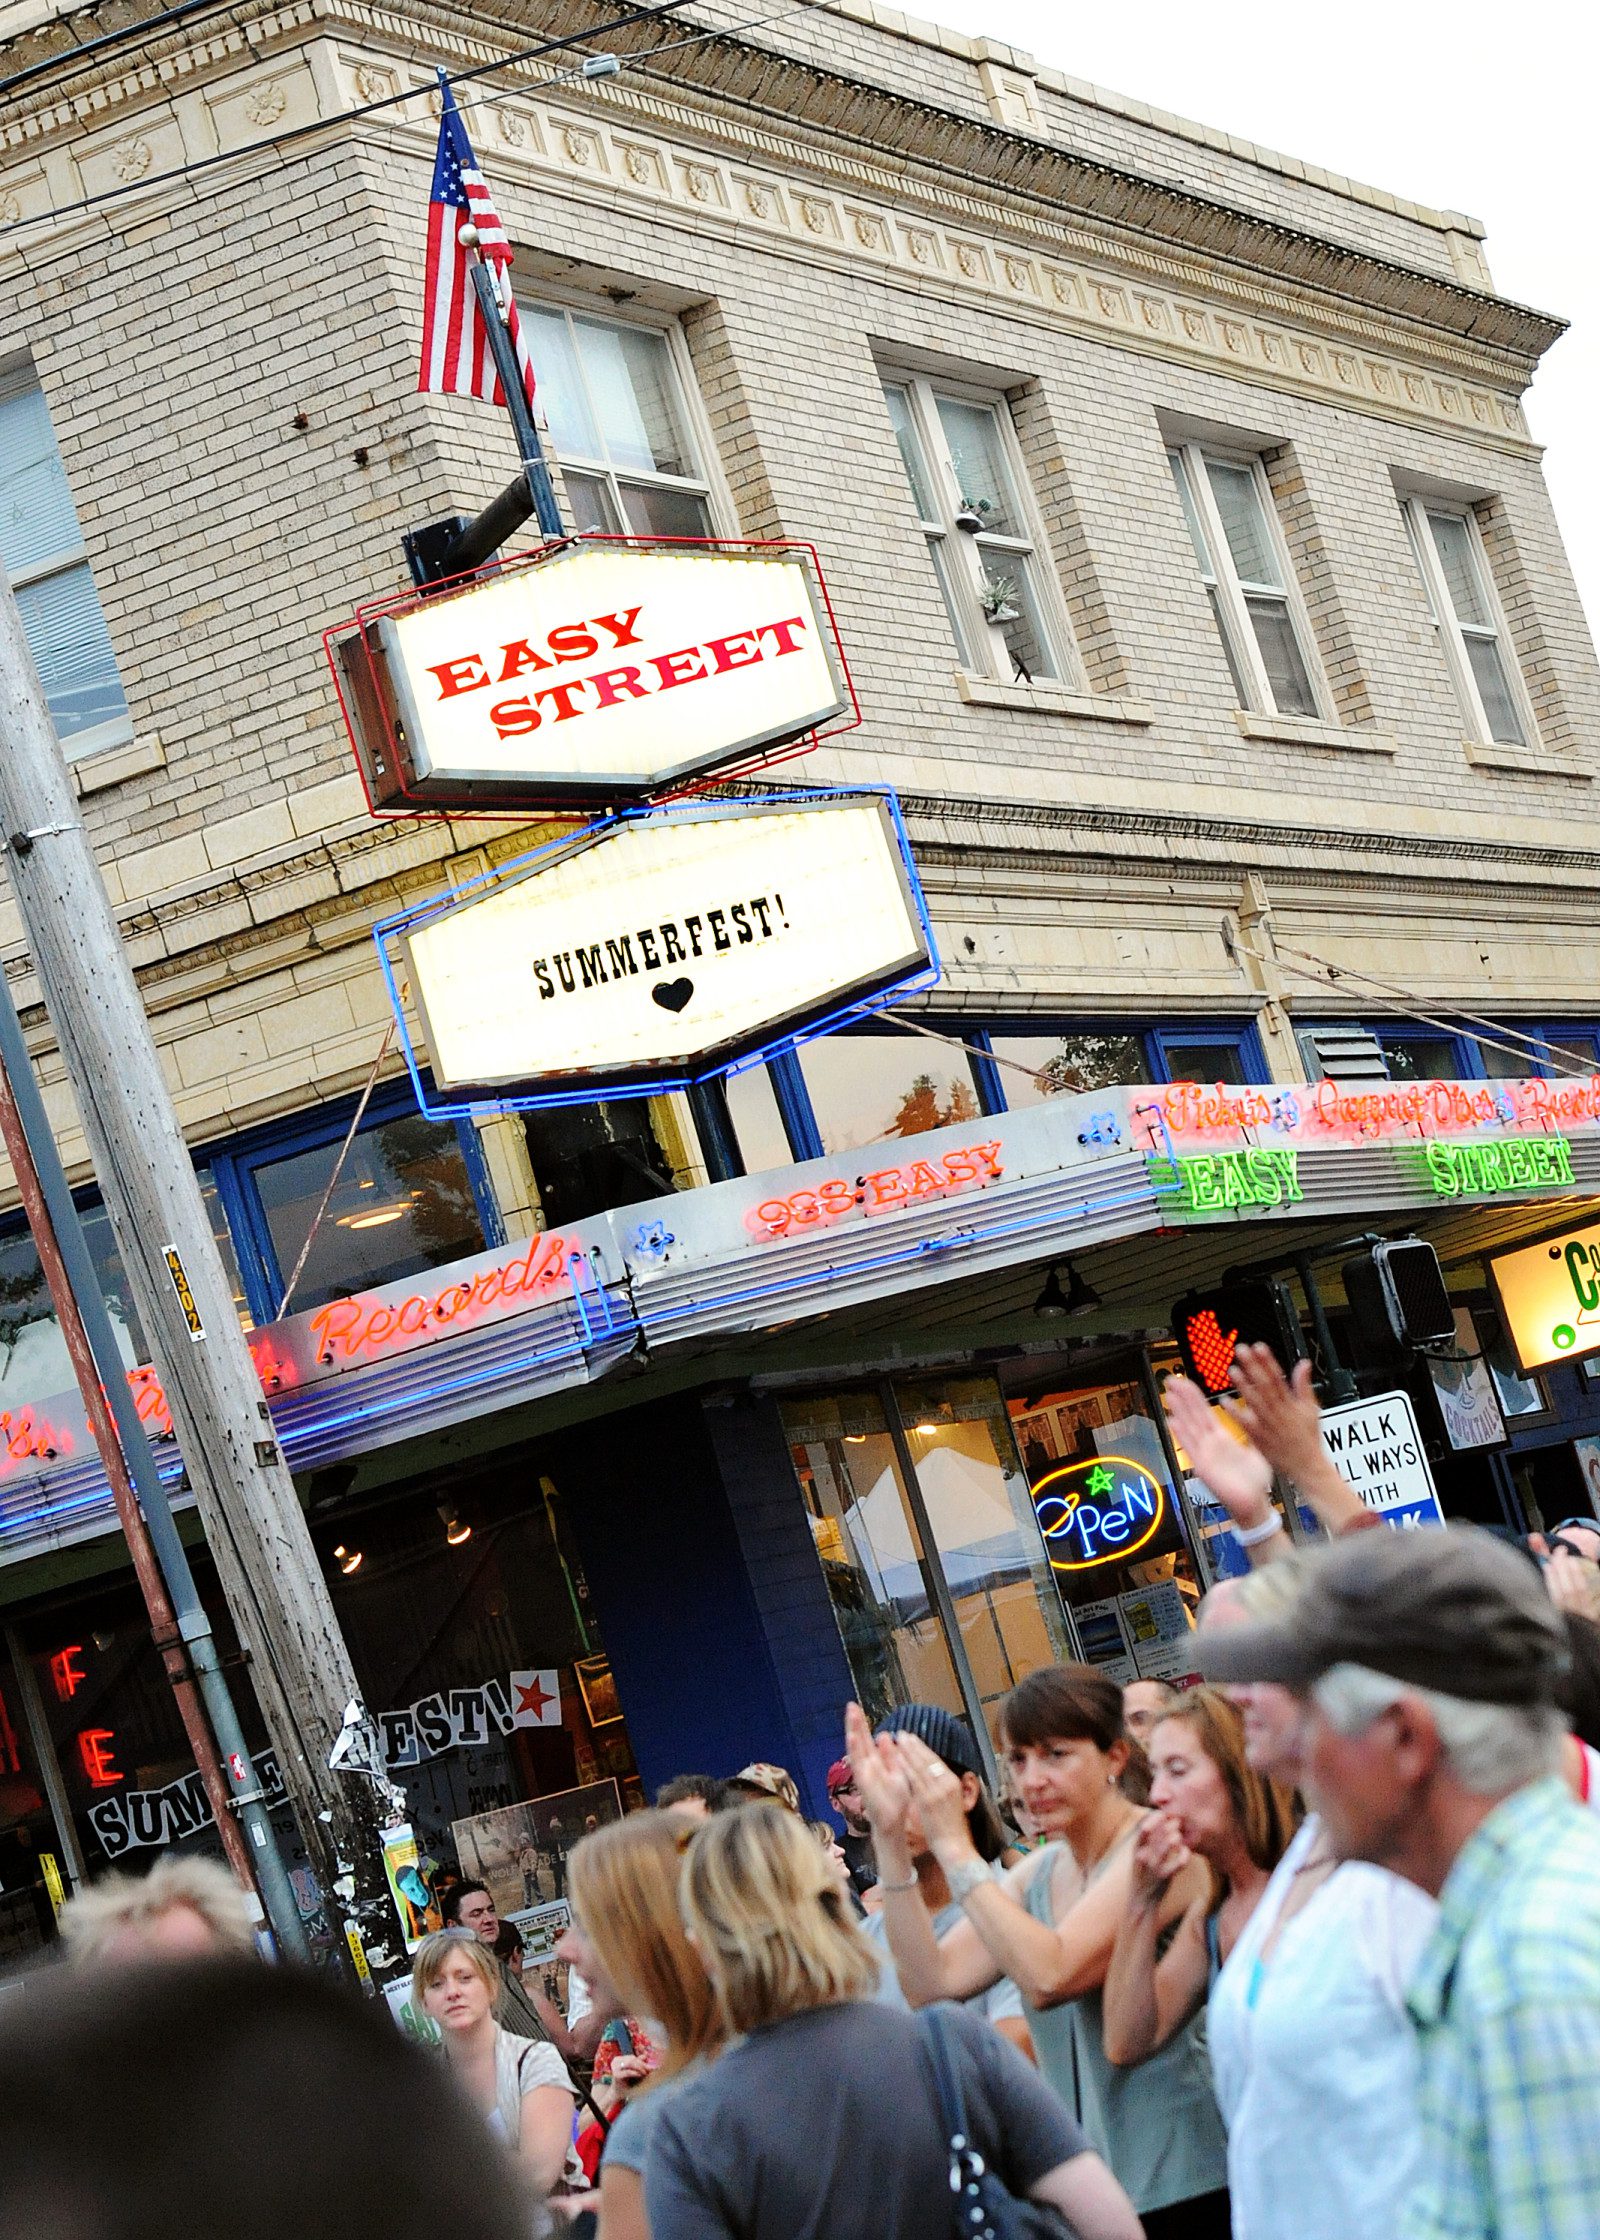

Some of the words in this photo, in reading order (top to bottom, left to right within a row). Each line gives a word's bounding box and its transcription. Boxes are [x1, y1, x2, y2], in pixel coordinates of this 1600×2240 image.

[426, 606, 644, 700] EASY
[489, 616, 806, 740] STREET
[533, 894, 791, 1000] SUMMERFEST!
[1182, 1146, 1303, 1210] EASY
[1427, 1138, 1575, 1196] STREET
[167, 1252, 202, 1332] 4302
[310, 1233, 563, 1363] Records
[1323, 1413, 1397, 1452] WALK
[1445, 1397, 1500, 1444] COCKTAILS
[1335, 1461, 1361, 1483] LL
[1364, 1443, 1417, 1475] WAYS
